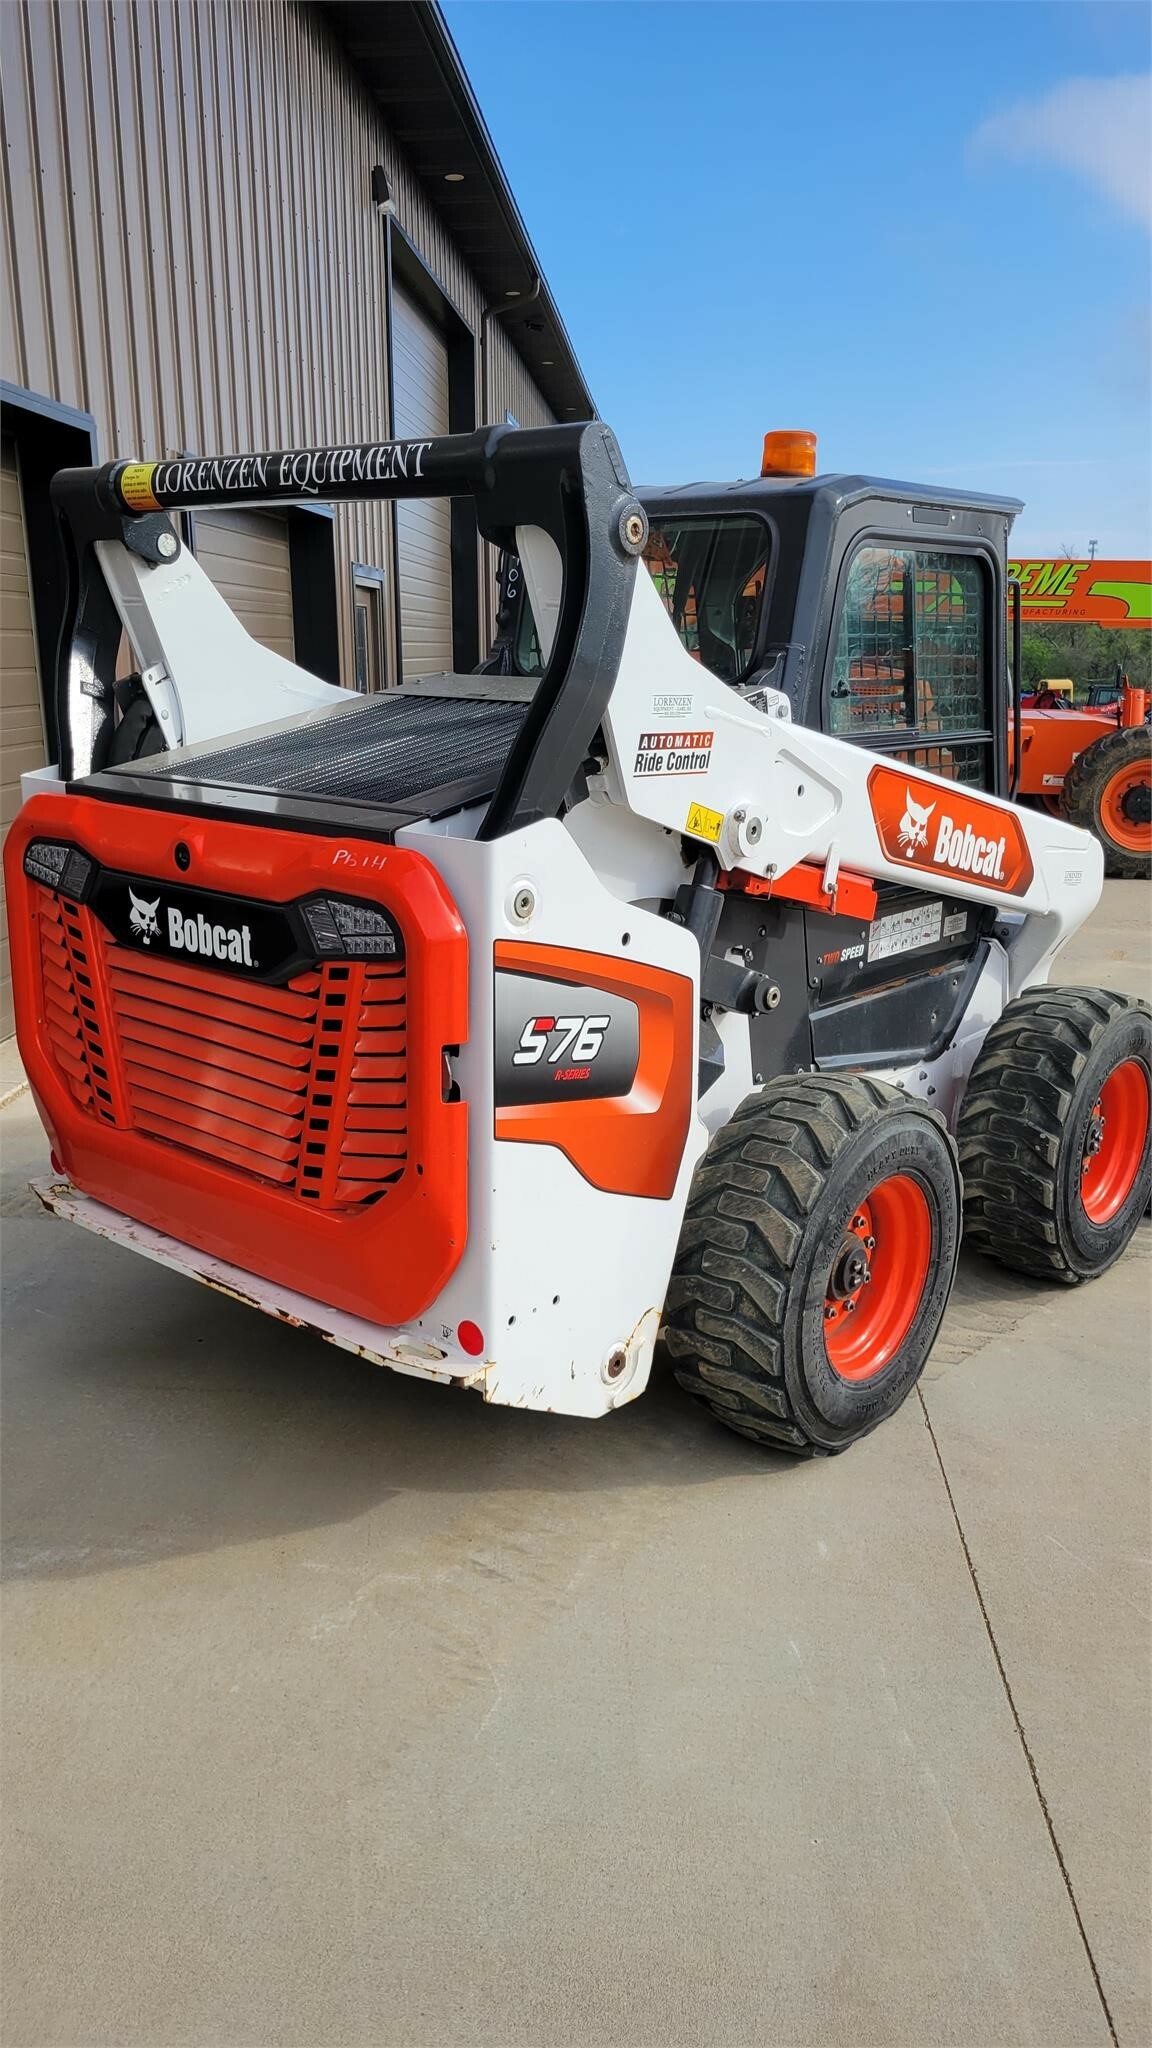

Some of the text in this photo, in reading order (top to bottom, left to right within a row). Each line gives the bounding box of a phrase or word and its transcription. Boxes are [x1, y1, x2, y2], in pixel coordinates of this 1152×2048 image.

[155, 442, 433, 494] LORENZEN EQUIPMENT
[1009, 608, 1087, 616] UFACTURING
[653, 697, 692, 706] LORENZEN
[641, 734, 711, 749] AUTOMATIC
[634, 751, 711, 773] Ride Control
[933, 815, 1005, 880] Bobcat
[167, 907, 253, 967] Bobcat
[823, 944, 864, 966] TWO SPEED
[512, 1015, 611, 1066] S76
[555, 1067, 591, 1080] R-SERIES
